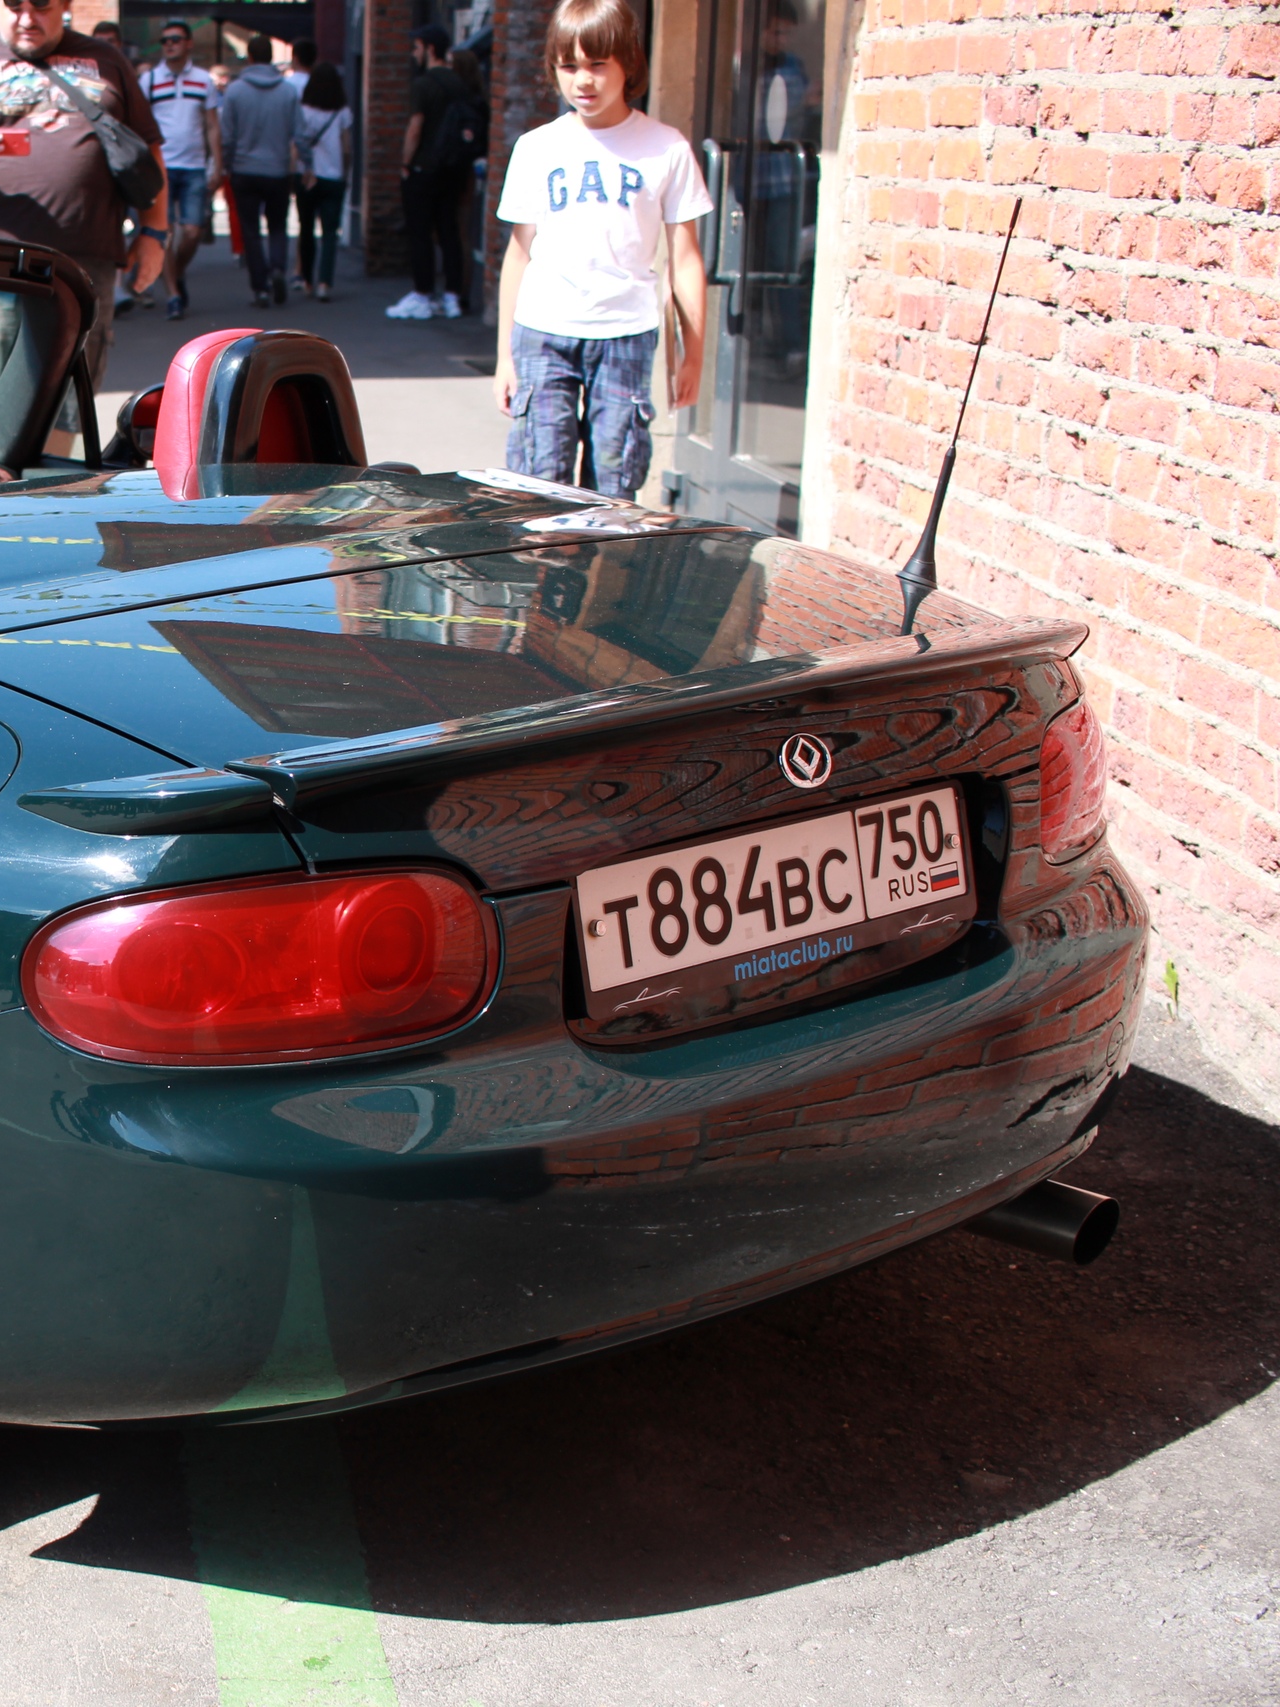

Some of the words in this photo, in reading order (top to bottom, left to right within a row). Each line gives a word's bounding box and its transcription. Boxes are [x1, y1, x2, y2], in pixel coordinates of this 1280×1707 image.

[547, 160, 644, 212] GAP
[602, 844, 853, 969] T884BC
[858, 798, 945, 879] 750
[888, 870, 929, 902] RUS
[733, 933, 853, 981] miataclub.ru
